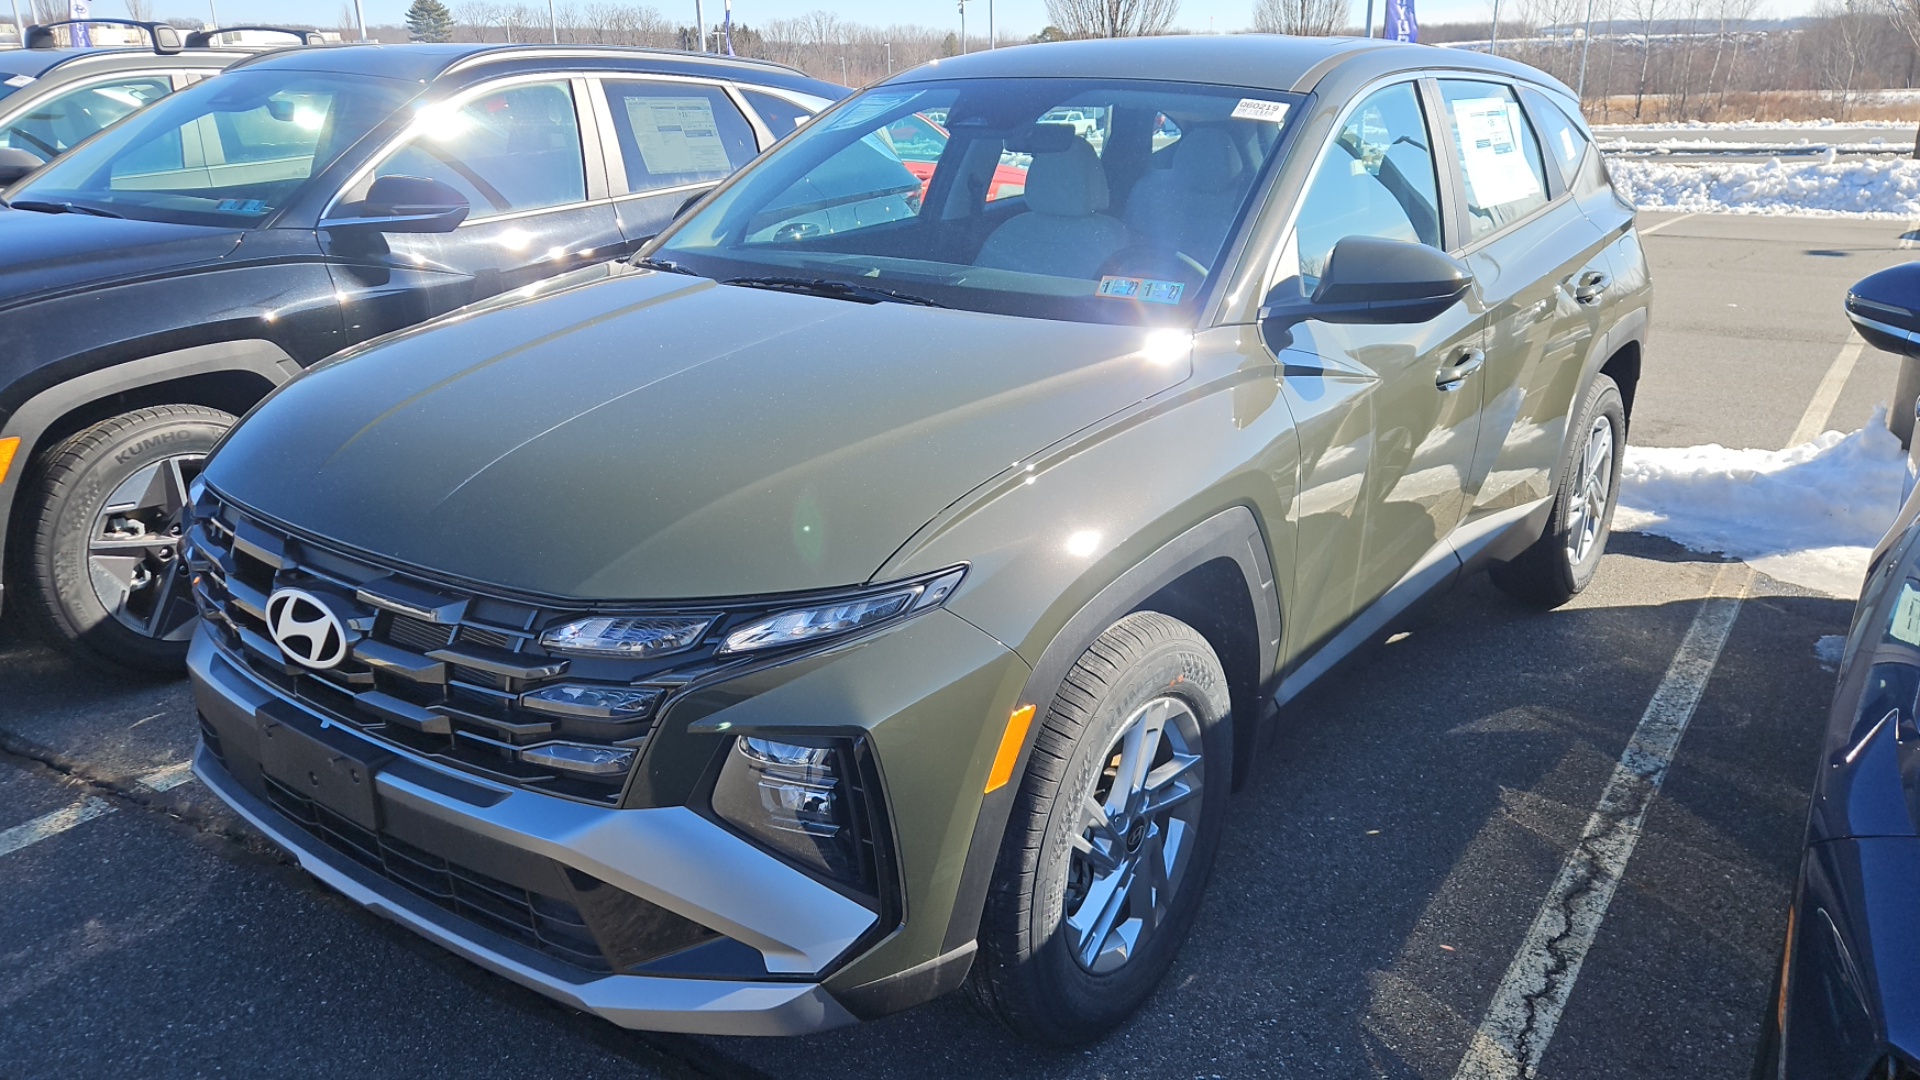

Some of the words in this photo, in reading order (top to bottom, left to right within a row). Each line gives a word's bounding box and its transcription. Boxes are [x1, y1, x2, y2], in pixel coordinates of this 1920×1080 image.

[1126, 281, 1139, 296] 27
[1167, 284, 1180, 300] 27
[114, 429, 191, 465] KUMHO
